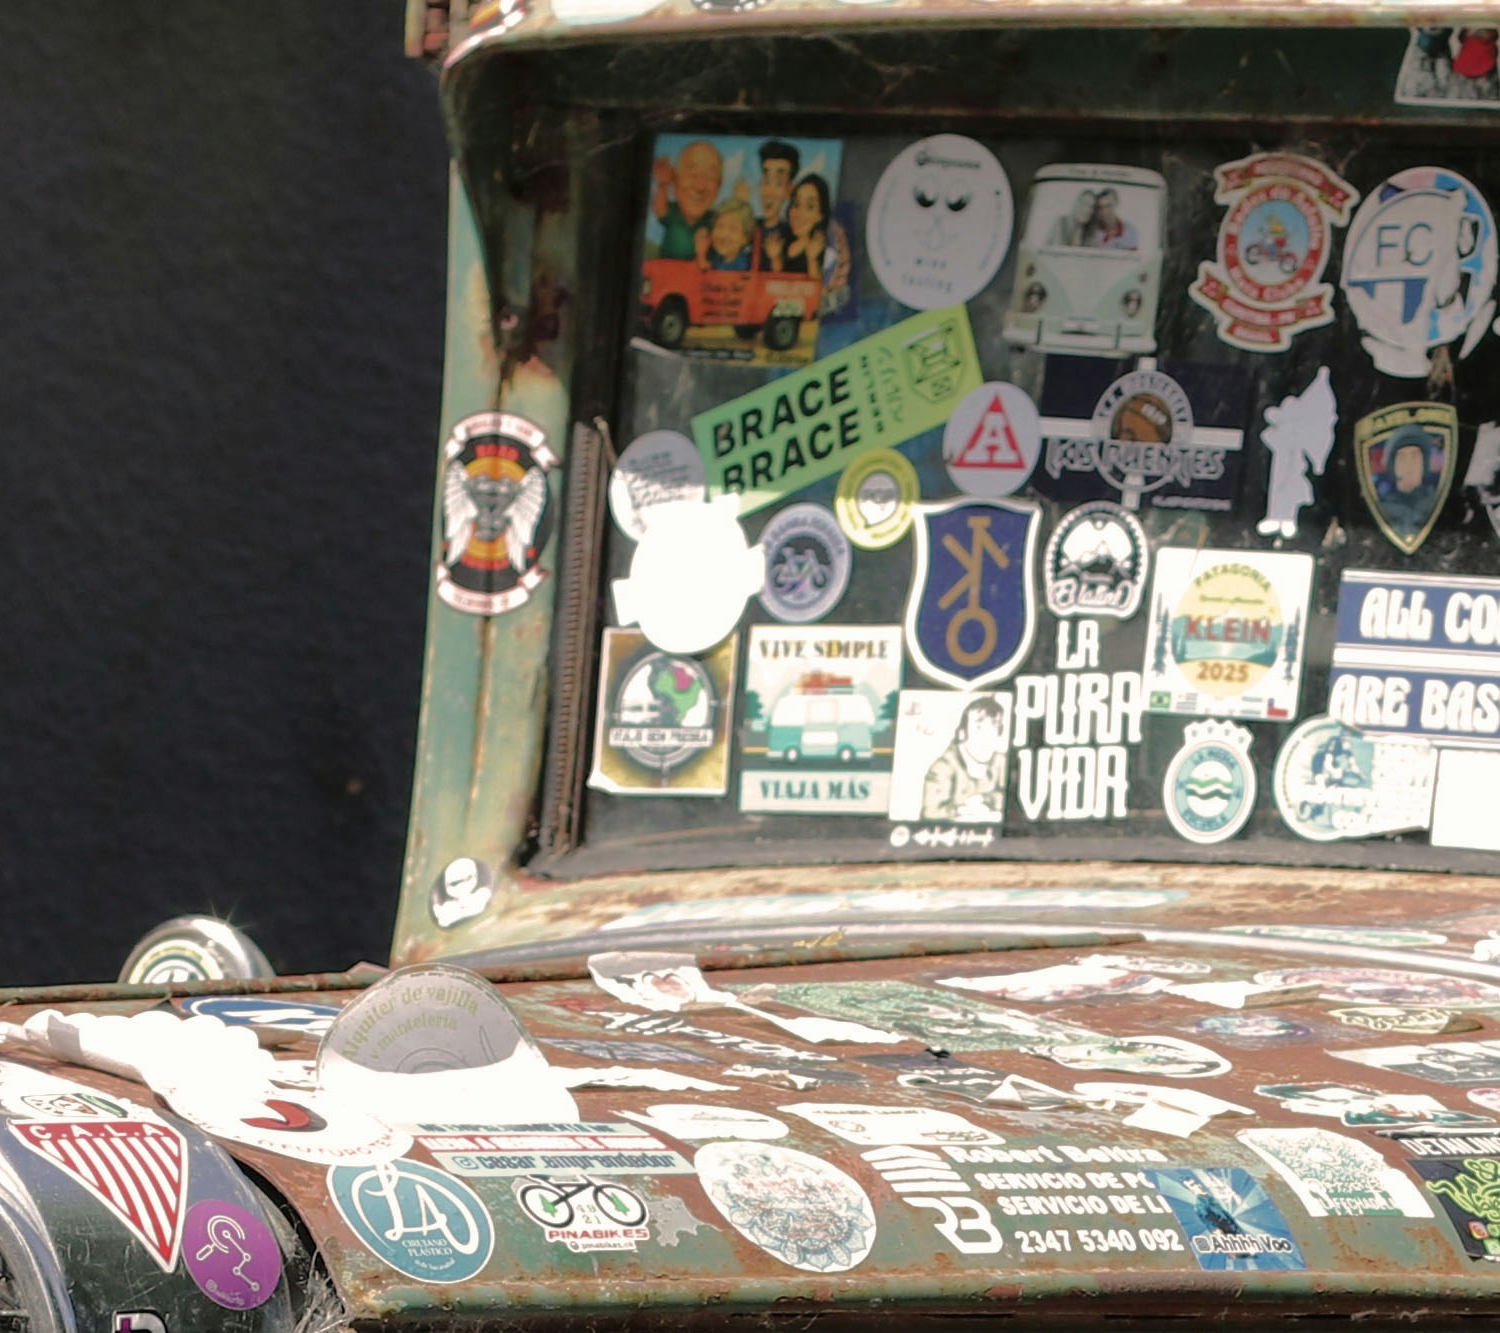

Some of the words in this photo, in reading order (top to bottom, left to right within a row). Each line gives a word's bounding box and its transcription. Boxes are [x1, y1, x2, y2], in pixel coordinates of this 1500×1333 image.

[712, 366, 851, 459] BRACE
[721, 409, 861, 495] BRACE
[1193, 563, 1271, 593] PATAGONIA
[1182, 616, 1270, 645] KLEIN
[1360, 587, 1432, 644] ALL
[758, 639, 806, 659] VIVE
[811, 639, 888, 659] SIMPLE
[1057, 620, 1098, 669] LA
[1196, 662, 1250, 683] 2025
[1015, 672, 1141, 746] PURA
[758, 779, 820, 802] VIAJA
[825, 777, 871, 802] MÁS
[1018, 747, 1129, 821] VIDA
[549, 1228, 649, 1240] PINABIKES
[1015, 1230, 1075, 1254] 2347
[1079, 1230, 1137, 1253] 5340
[1140, 1230, 1184, 1252] 092
